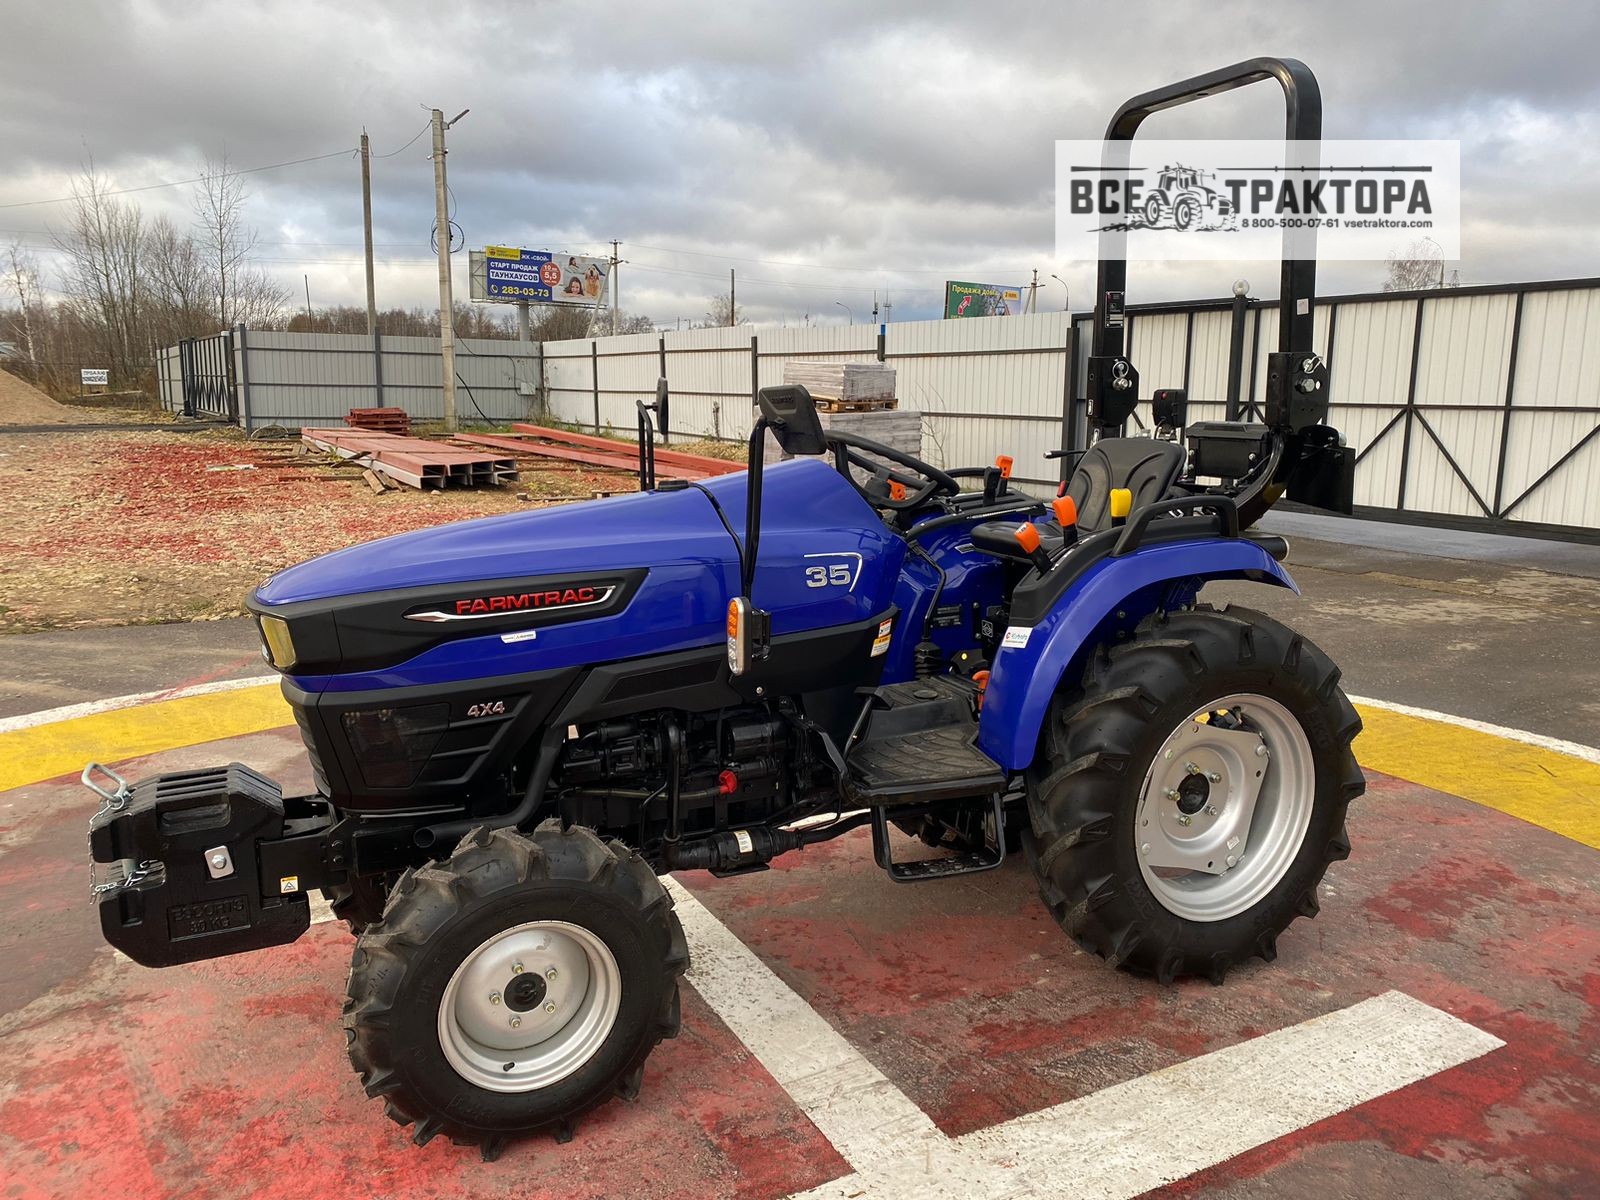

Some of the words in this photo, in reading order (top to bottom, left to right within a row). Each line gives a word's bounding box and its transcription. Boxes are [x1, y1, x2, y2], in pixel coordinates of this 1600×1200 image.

[491, 271, 538, 281] ТАУНХАУСОВ
[502, 286, 549, 297] 283-03-73
[952, 284, 981, 296] Продажа
[805, 564, 851, 588] 35
[456, 587, 595, 615] FARMTRAC
[467, 701, 505, 717] 4X4
